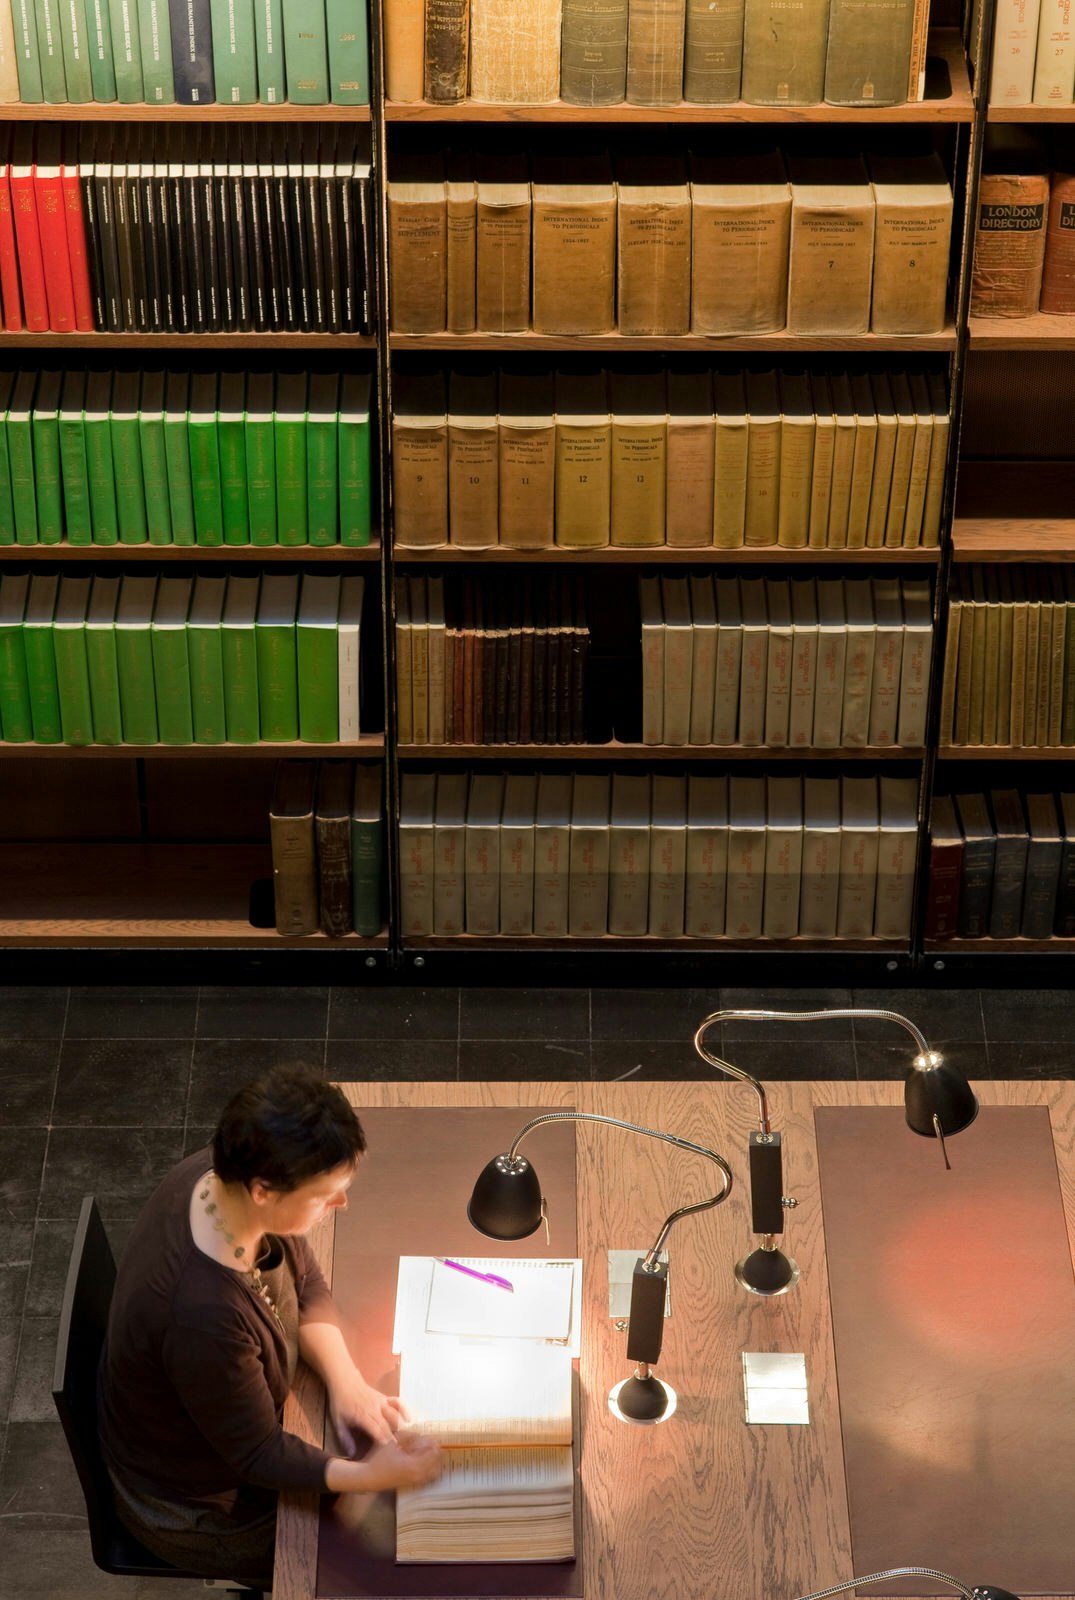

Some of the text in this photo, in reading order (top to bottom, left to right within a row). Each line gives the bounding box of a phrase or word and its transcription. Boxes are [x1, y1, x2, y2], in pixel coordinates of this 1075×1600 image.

[988, 207, 1037, 217] LONDON
[981, 217, 1042, 229] DIRECTORY
[828, 260, 834, 268] 7
[909, 259, 916, 268] 8
[469, 476, 480, 485] 10
[521, 477, 529, 485] 11
[579, 475, 588, 483] 12
